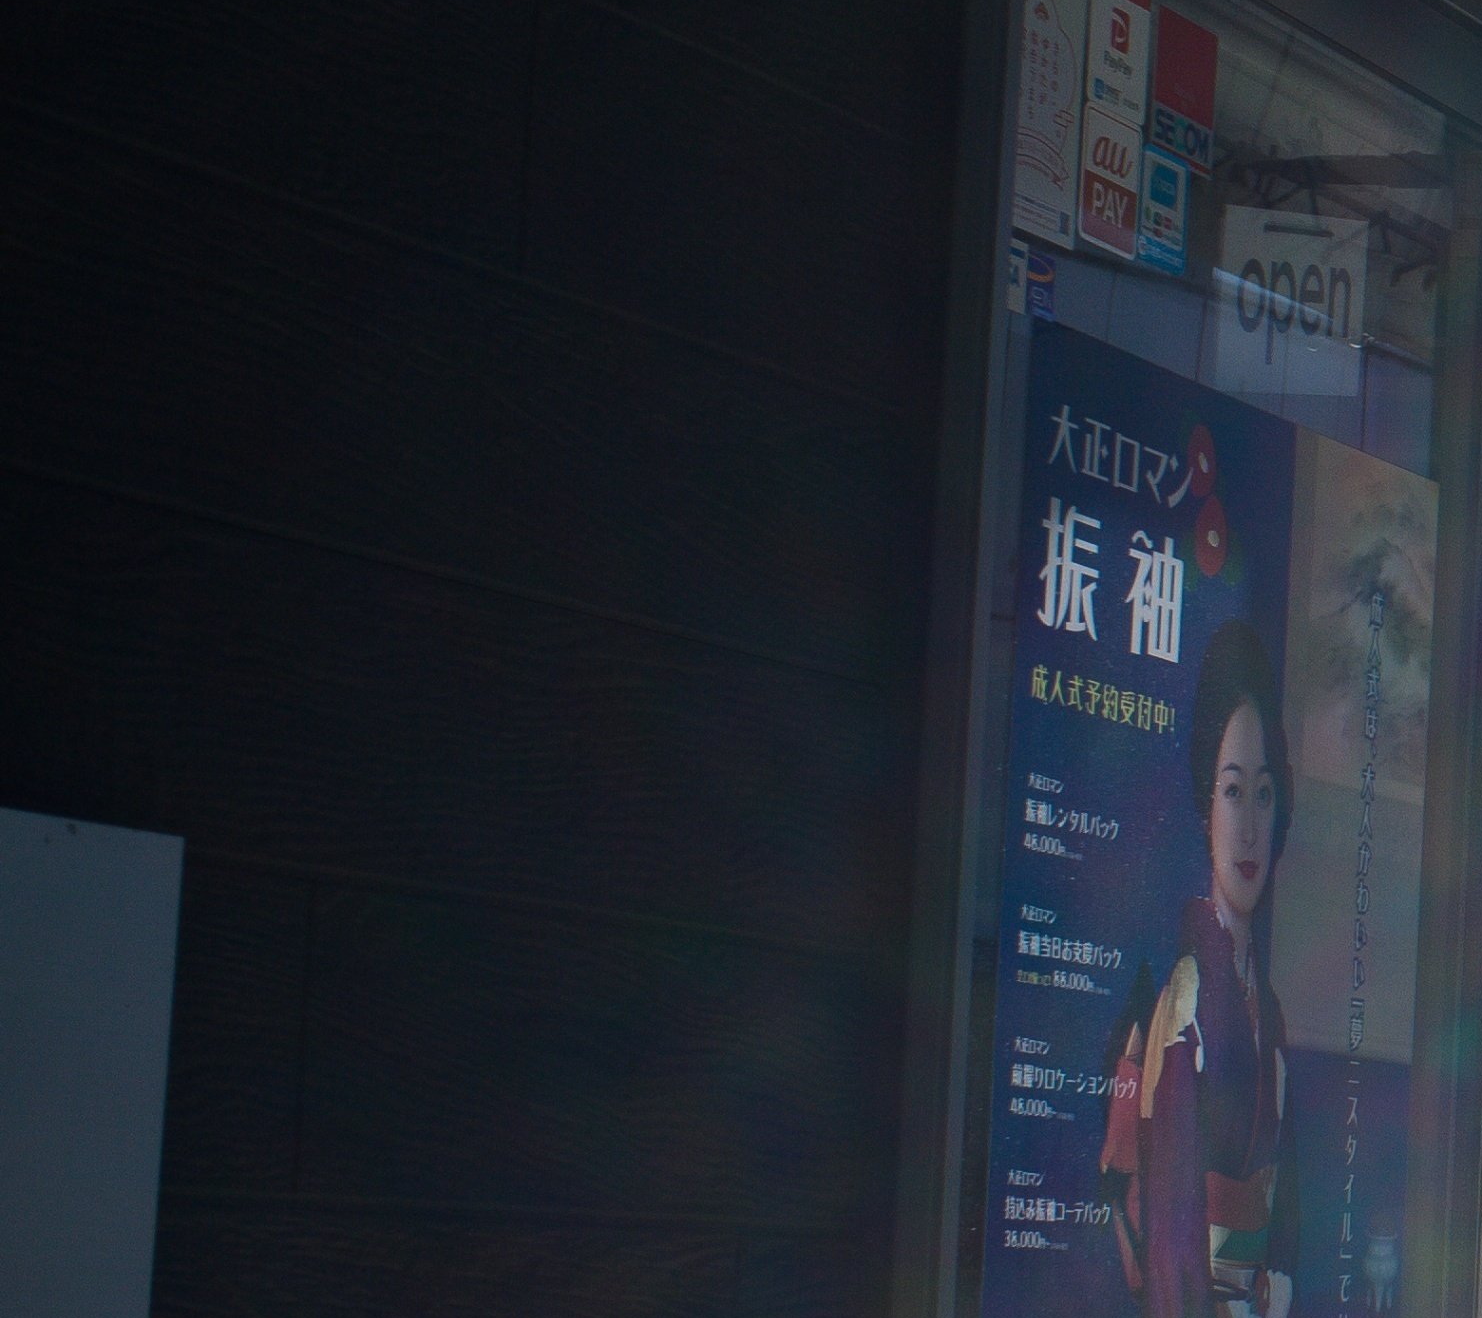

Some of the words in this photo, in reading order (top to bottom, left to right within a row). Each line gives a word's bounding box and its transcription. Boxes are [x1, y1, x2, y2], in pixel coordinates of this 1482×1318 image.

[1093, 136, 1132, 178] au
[1091, 183, 1127, 229] PAY
[1237, 258, 1352, 366] open
[1047, 404, 1194, 508] 大正ロマン
[1037, 496, 1184, 664] 振袖
[1031, 664, 1177, 735] 成人式予約受付中!
[1028, 771, 1064, 794] 大正ロマン
[1021, 903, 1057, 924] 大正ロマン
[1014, 1036, 1051, 1055] 大正ロマン
[1008, 1169, 1045, 1186] 大正ロマン
